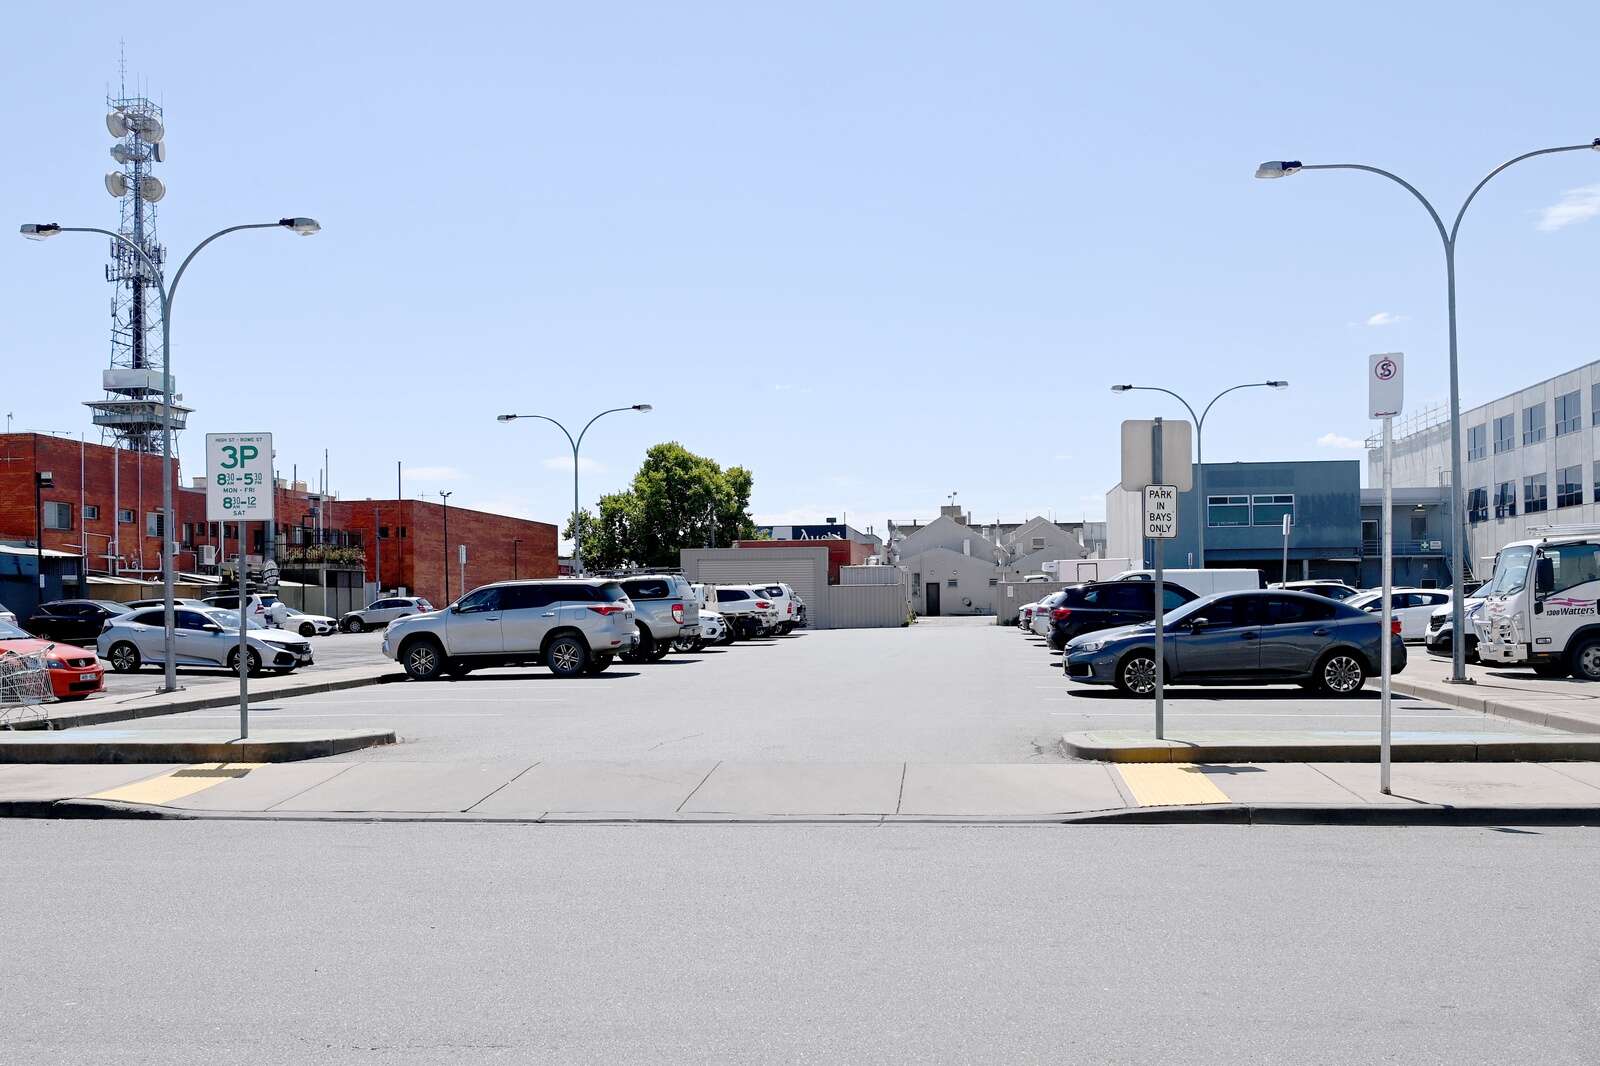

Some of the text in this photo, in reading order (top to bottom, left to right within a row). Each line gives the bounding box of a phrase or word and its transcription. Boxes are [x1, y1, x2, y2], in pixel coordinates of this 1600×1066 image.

[220, 445, 258, 469] 3P
[1149, 490, 1172, 499] PARK
[1156, 501, 1165, 510] IN
[1149, 512, 1172, 521] BAYS
[1149, 523, 1172, 533] ONLY
